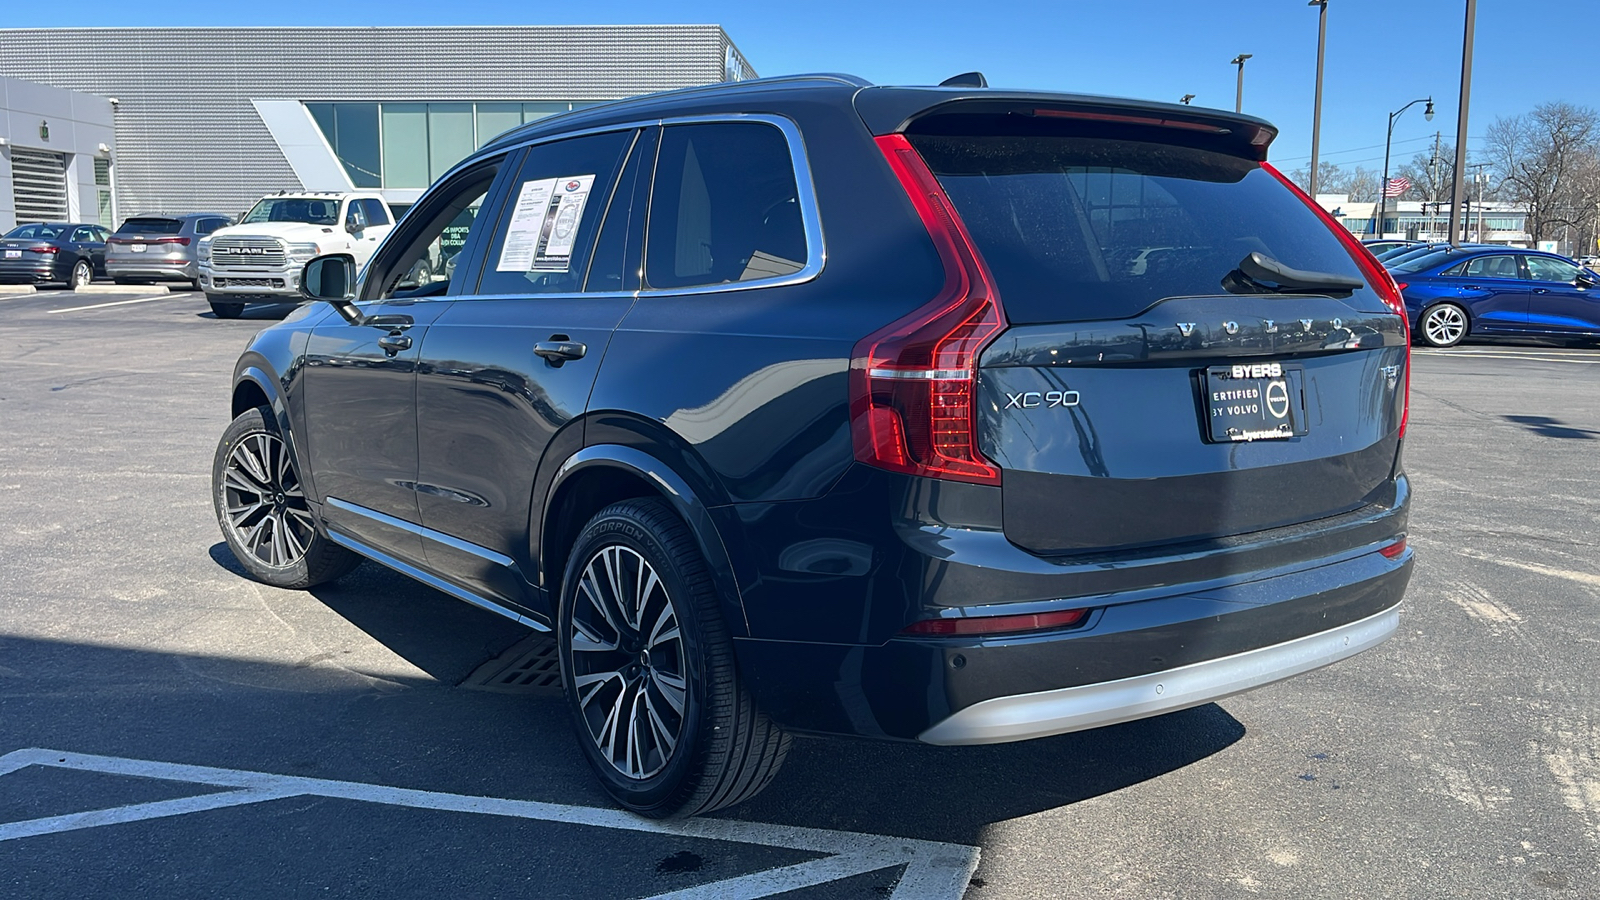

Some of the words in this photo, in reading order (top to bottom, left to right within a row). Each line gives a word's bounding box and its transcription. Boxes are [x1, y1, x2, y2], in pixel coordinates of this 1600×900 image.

[1175, 317, 1343, 337] VOLVO
[1232, 363, 1282, 378] BYERS
[1213, 389, 1258, 401] ERTIFIED
[1227, 404, 1258, 416] VOLVO
[586, 521, 644, 541] SCORPION
